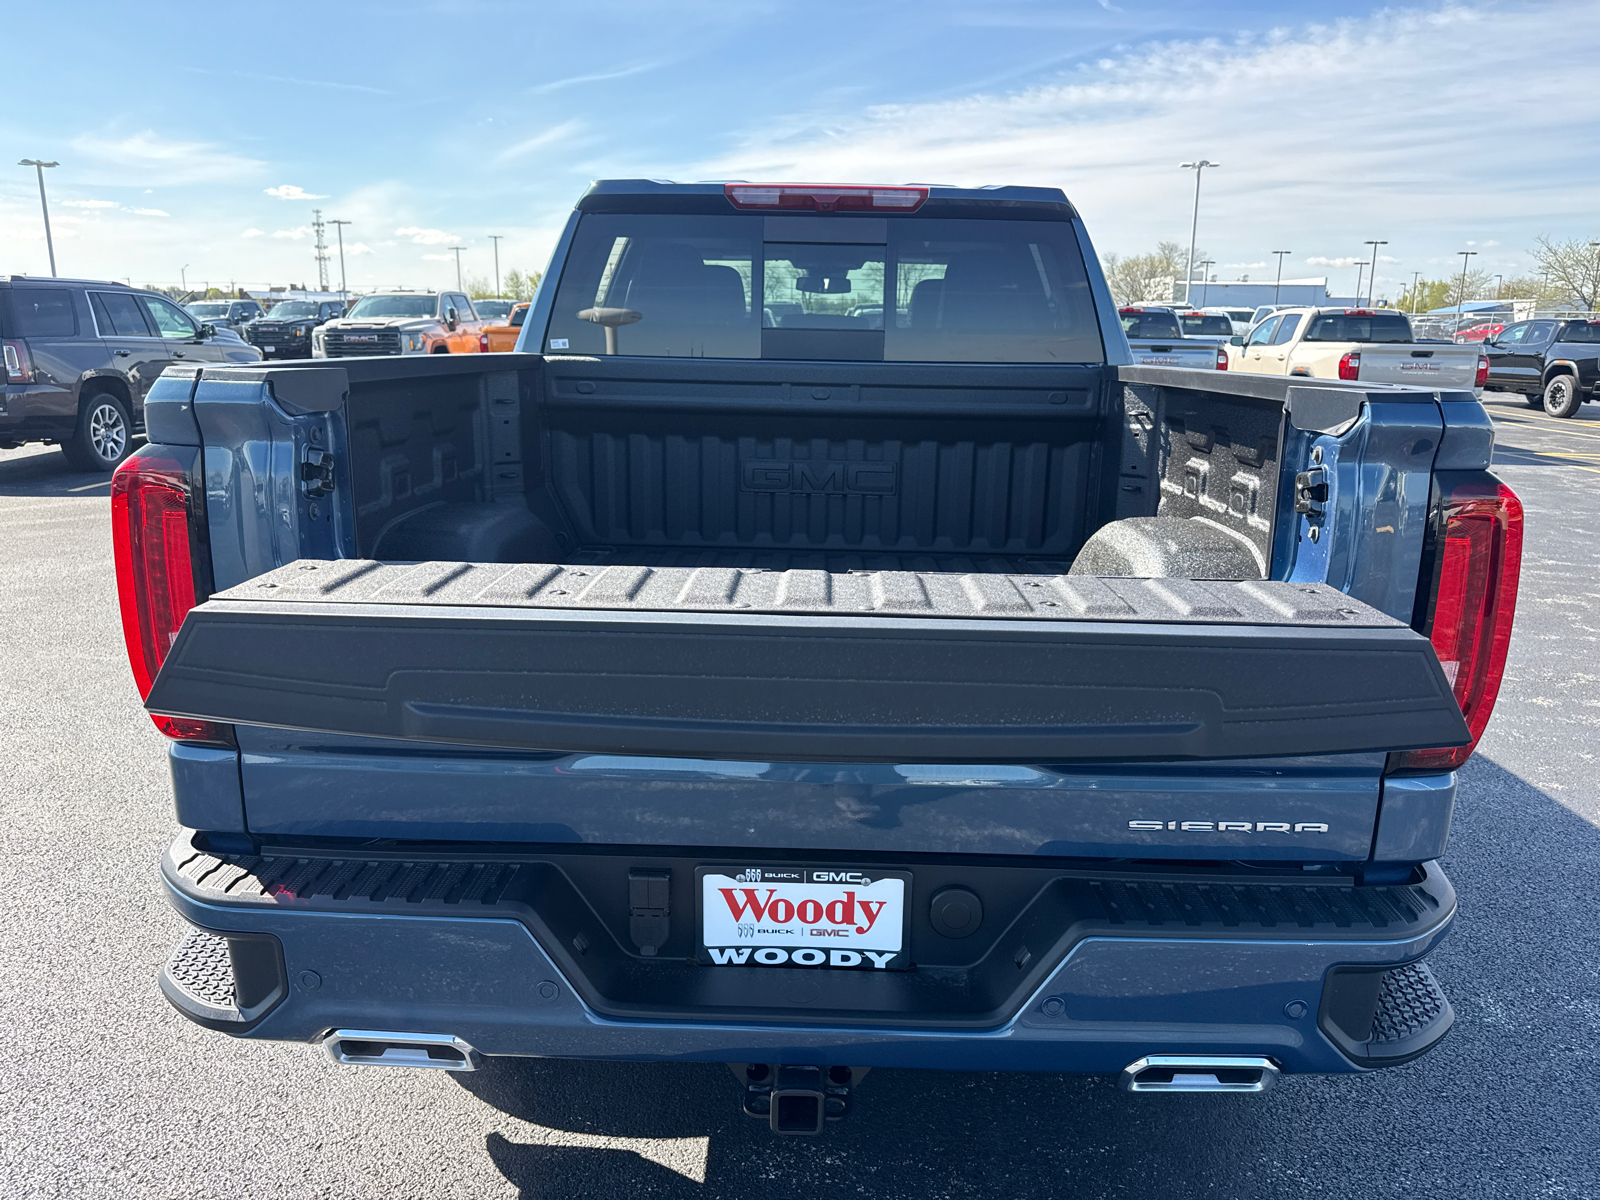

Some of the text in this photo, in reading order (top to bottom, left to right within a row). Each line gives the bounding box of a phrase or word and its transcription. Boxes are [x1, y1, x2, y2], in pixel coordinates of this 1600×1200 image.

[1141, 357, 1180, 365] GMC
[1400, 362, 1441, 370] GMC
[742, 461, 894, 493] GMC
[1127, 820, 1329, 834] SIERRA
[812, 872, 863, 882] GMC
[718, 888, 887, 935] Woody
[809, 928, 850, 938] GMC
[708, 948, 898, 969] WOODY
